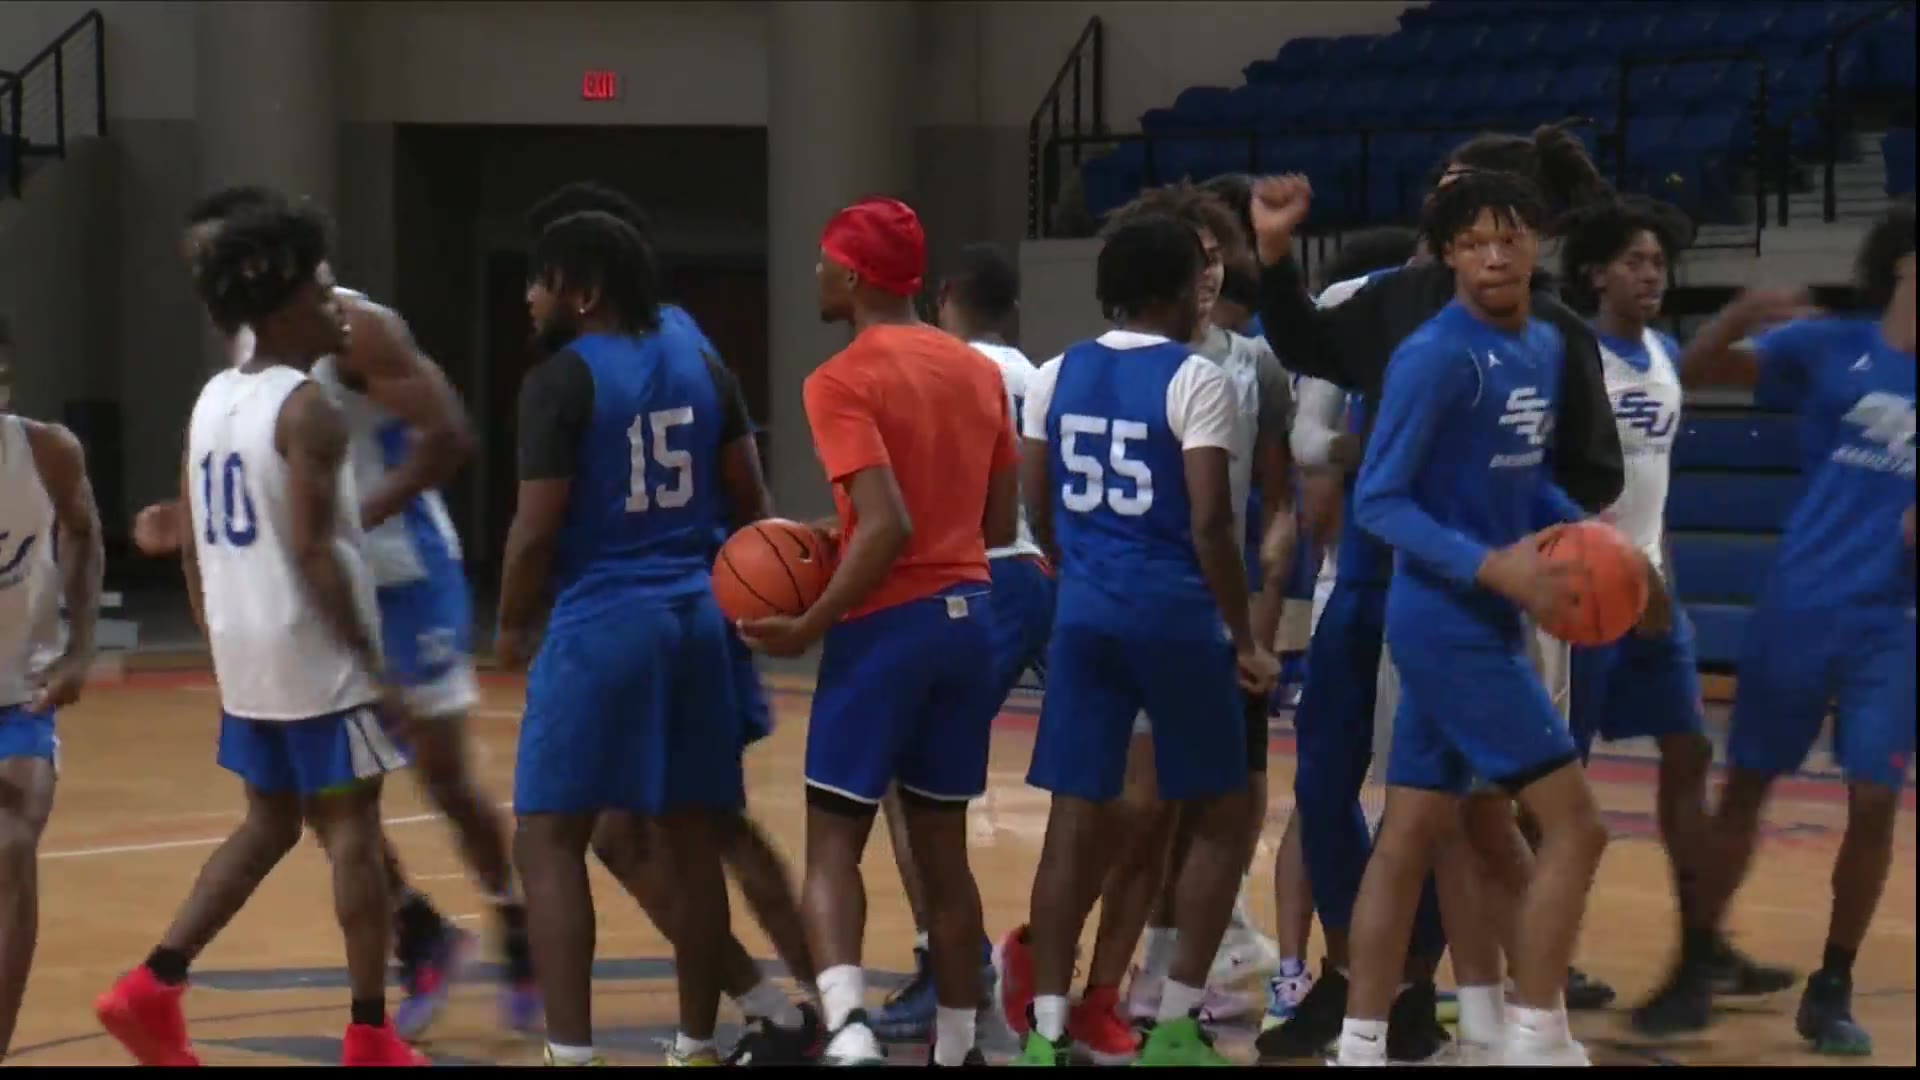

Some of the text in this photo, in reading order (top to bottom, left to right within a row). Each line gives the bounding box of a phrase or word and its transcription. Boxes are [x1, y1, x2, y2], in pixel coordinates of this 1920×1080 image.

[583, 71, 617, 98] EXIT
[201, 450, 257, 546] 10
[625, 406, 694, 512] 15
[1060, 413, 1154, 516] 55
